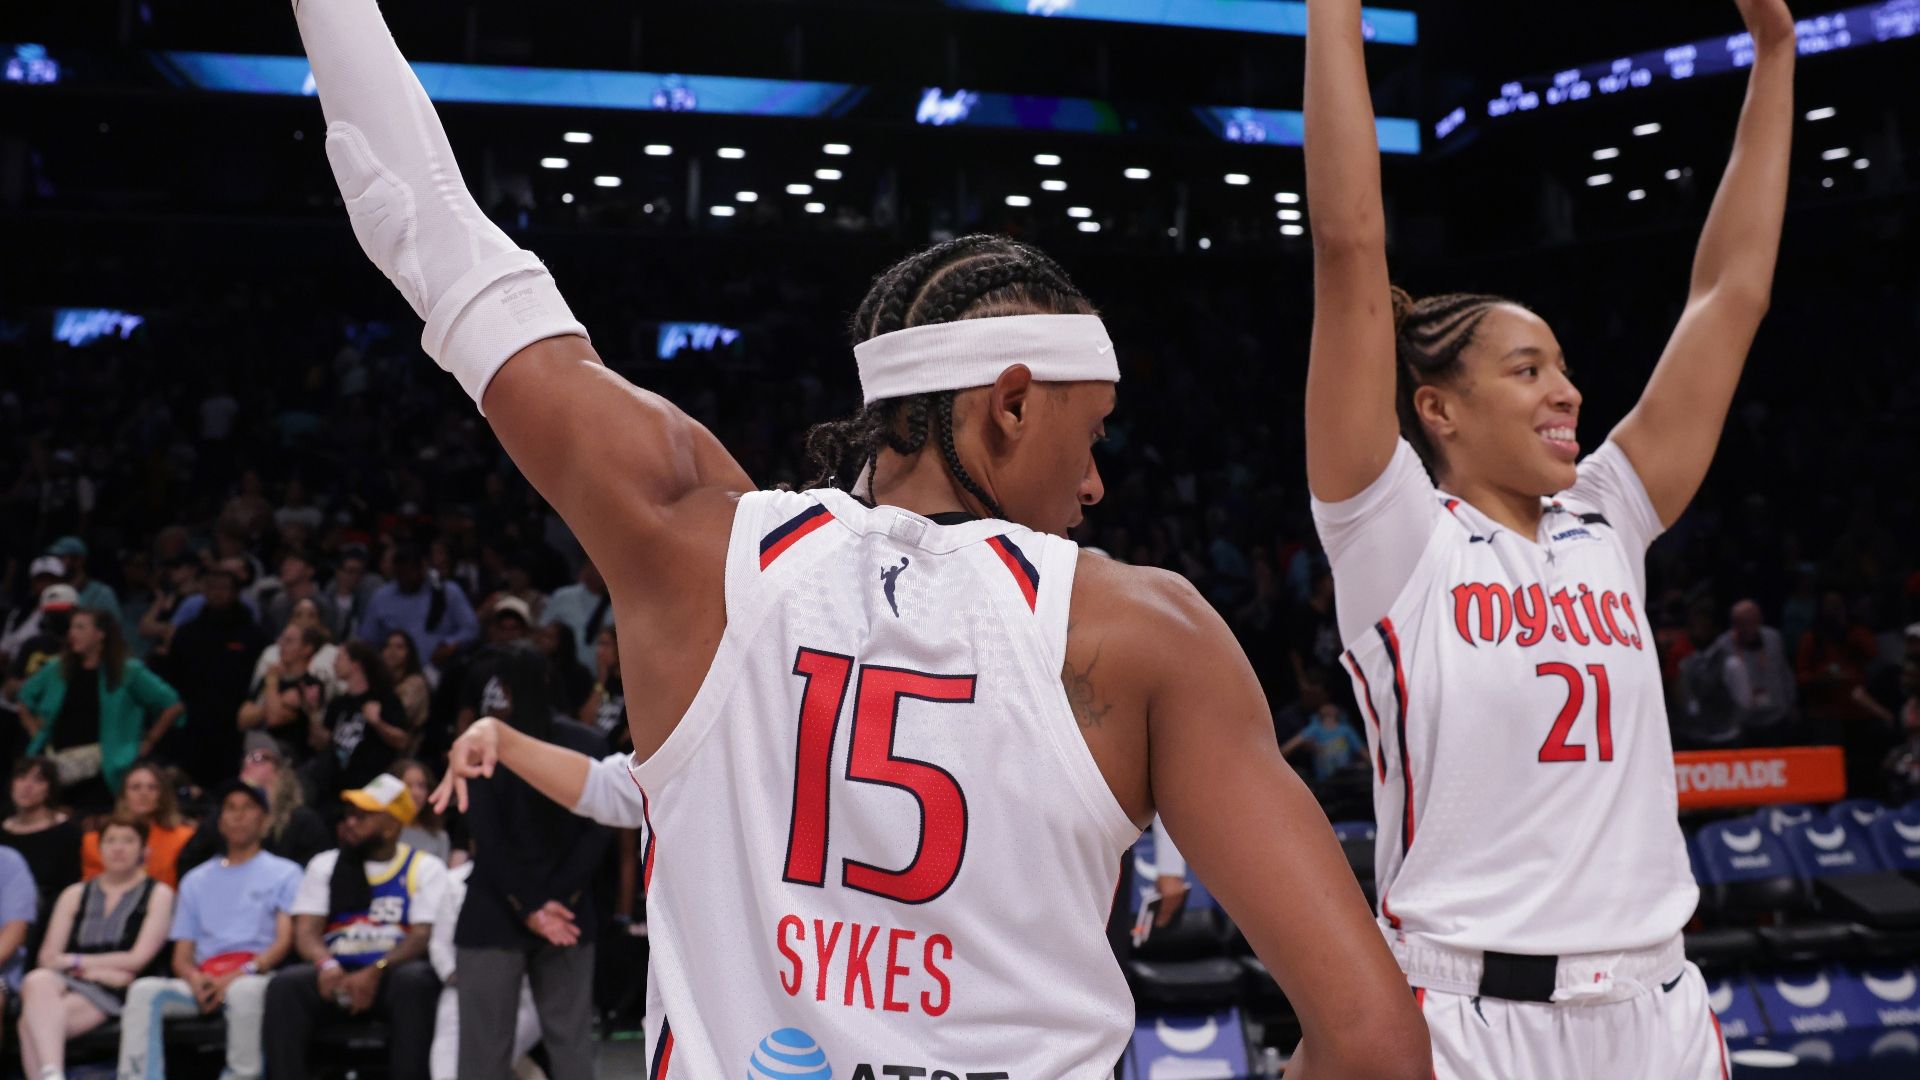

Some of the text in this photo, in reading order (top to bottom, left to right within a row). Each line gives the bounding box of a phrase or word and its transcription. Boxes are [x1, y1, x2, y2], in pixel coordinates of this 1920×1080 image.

[1536, 661, 1613, 763] 21
[782, 646, 977, 905] 15
[777, 914, 953, 1017] SYKES
